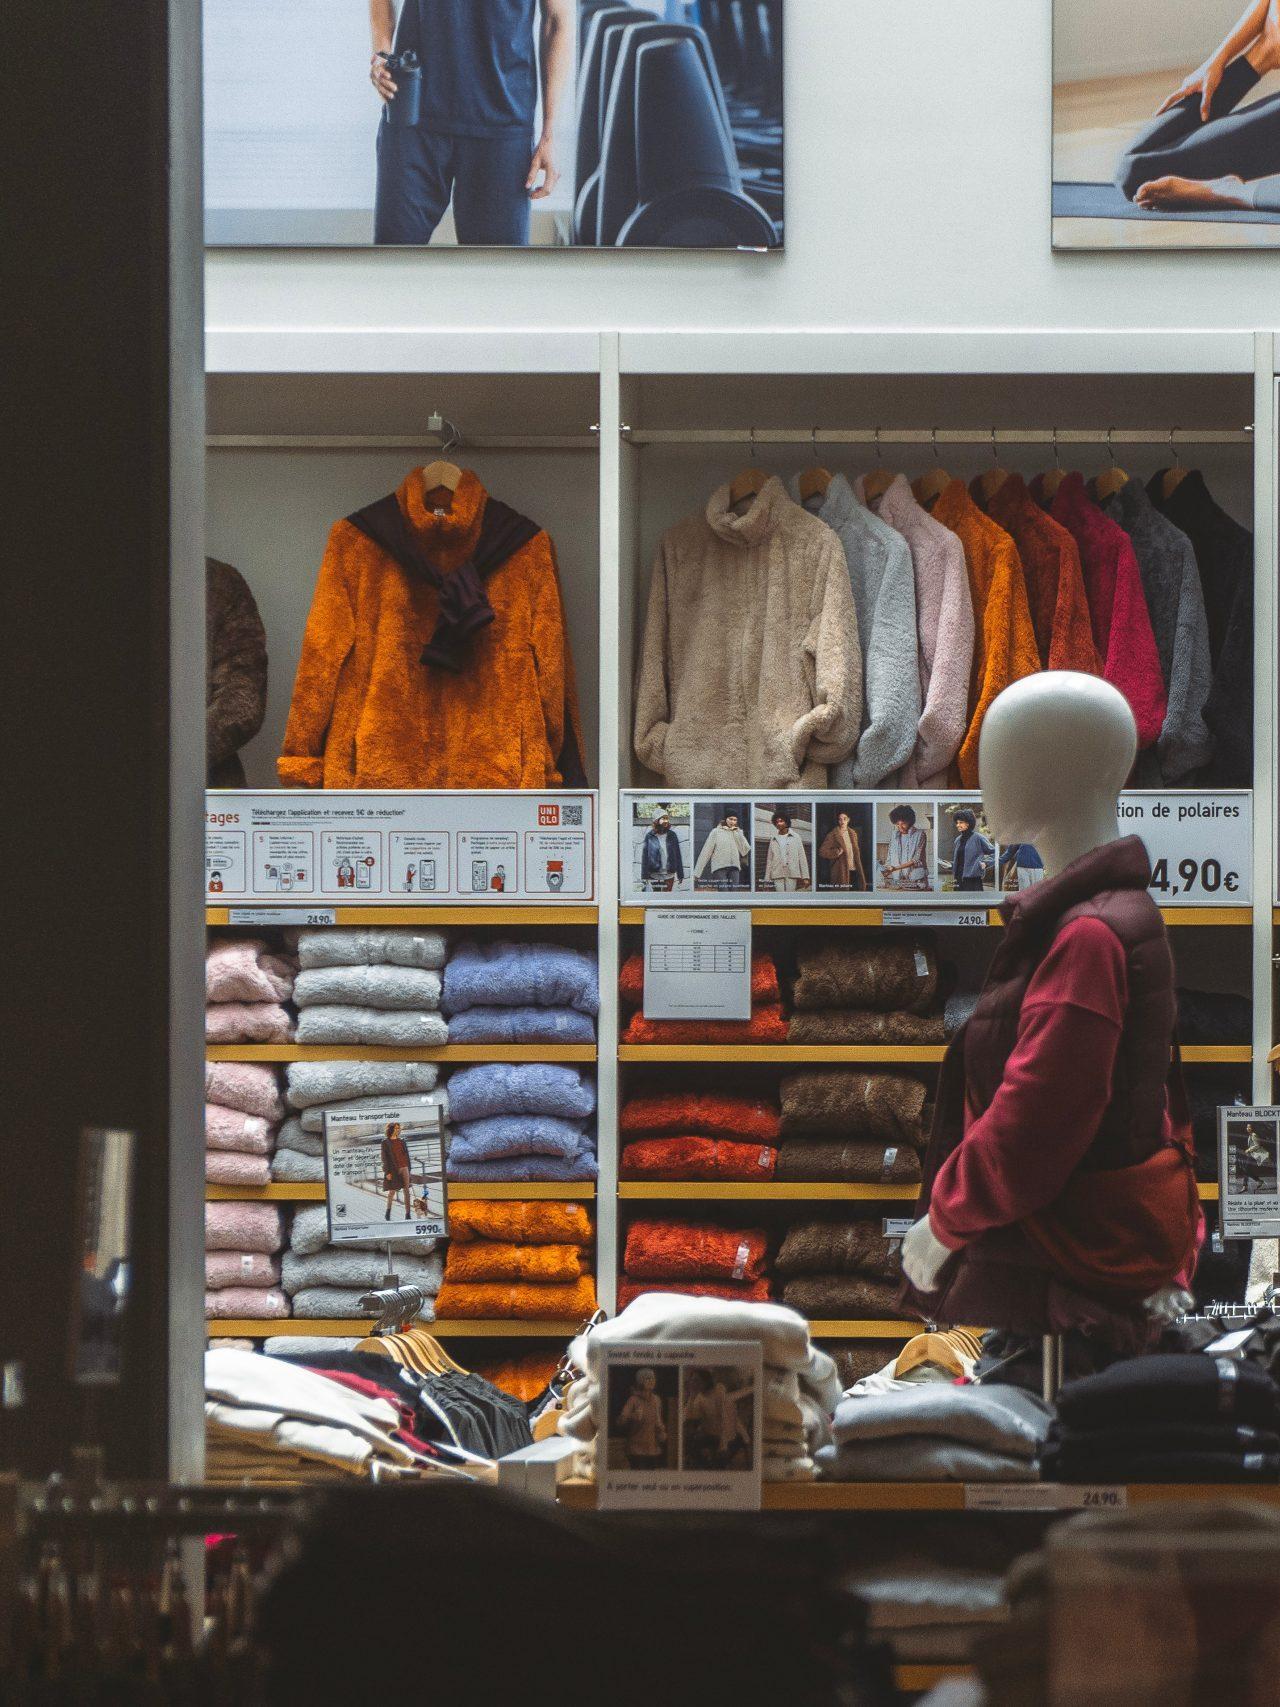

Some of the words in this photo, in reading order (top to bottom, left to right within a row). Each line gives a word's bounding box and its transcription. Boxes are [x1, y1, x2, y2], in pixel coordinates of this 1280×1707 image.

[540, 806, 556, 815] UNI
[1151, 802, 1171, 818] de
[1178, 801, 1240, 822] polaires
[540, 815, 557, 825] QLO
[358, 1111, 400, 1121] transportable
[1226, 1109, 1253, 1118] Manteau
